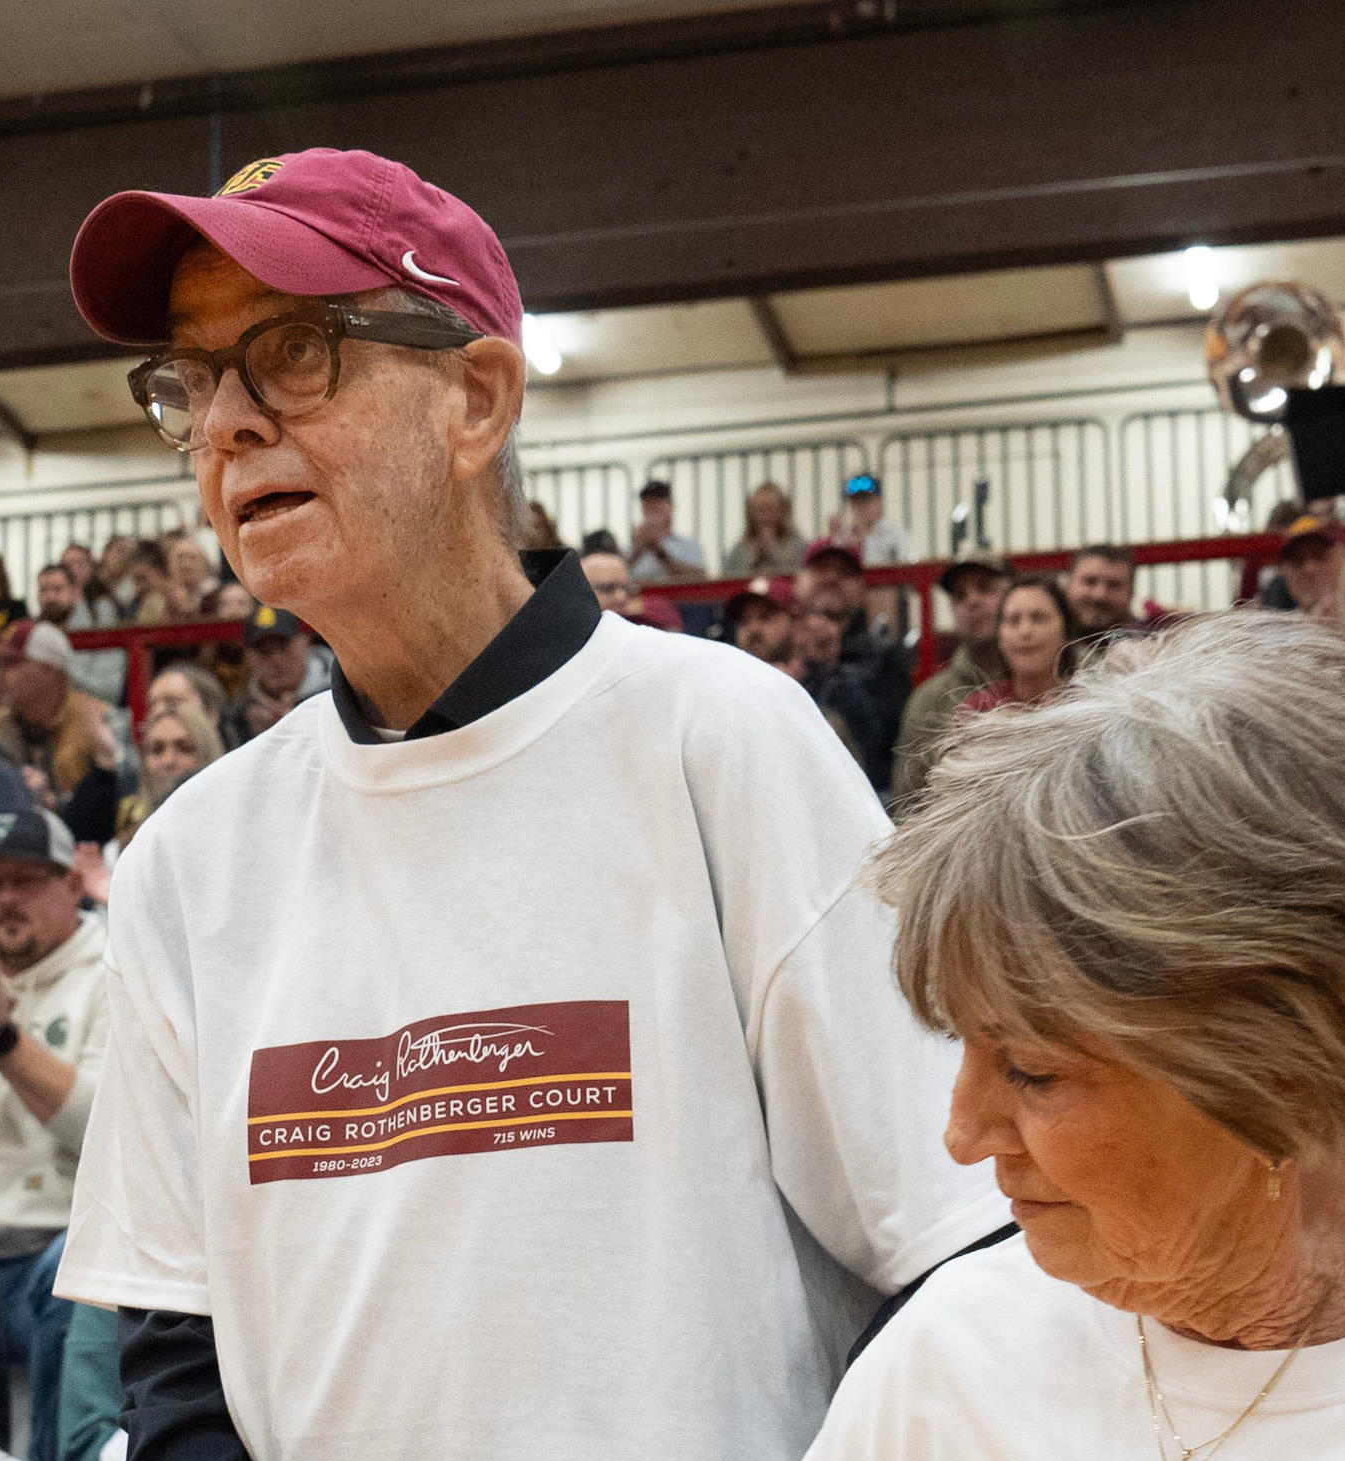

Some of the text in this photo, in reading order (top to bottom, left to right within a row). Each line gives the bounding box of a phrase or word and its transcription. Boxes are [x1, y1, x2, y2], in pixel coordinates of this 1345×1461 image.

[311, 1046, 390, 1101] Craig
[258, 1085, 617, 1147] CRAIG ROTHENBERGER COURT
[493, 1127, 556, 1145] 715 WINS
[312, 1154, 383, 1172] 1980-2023
